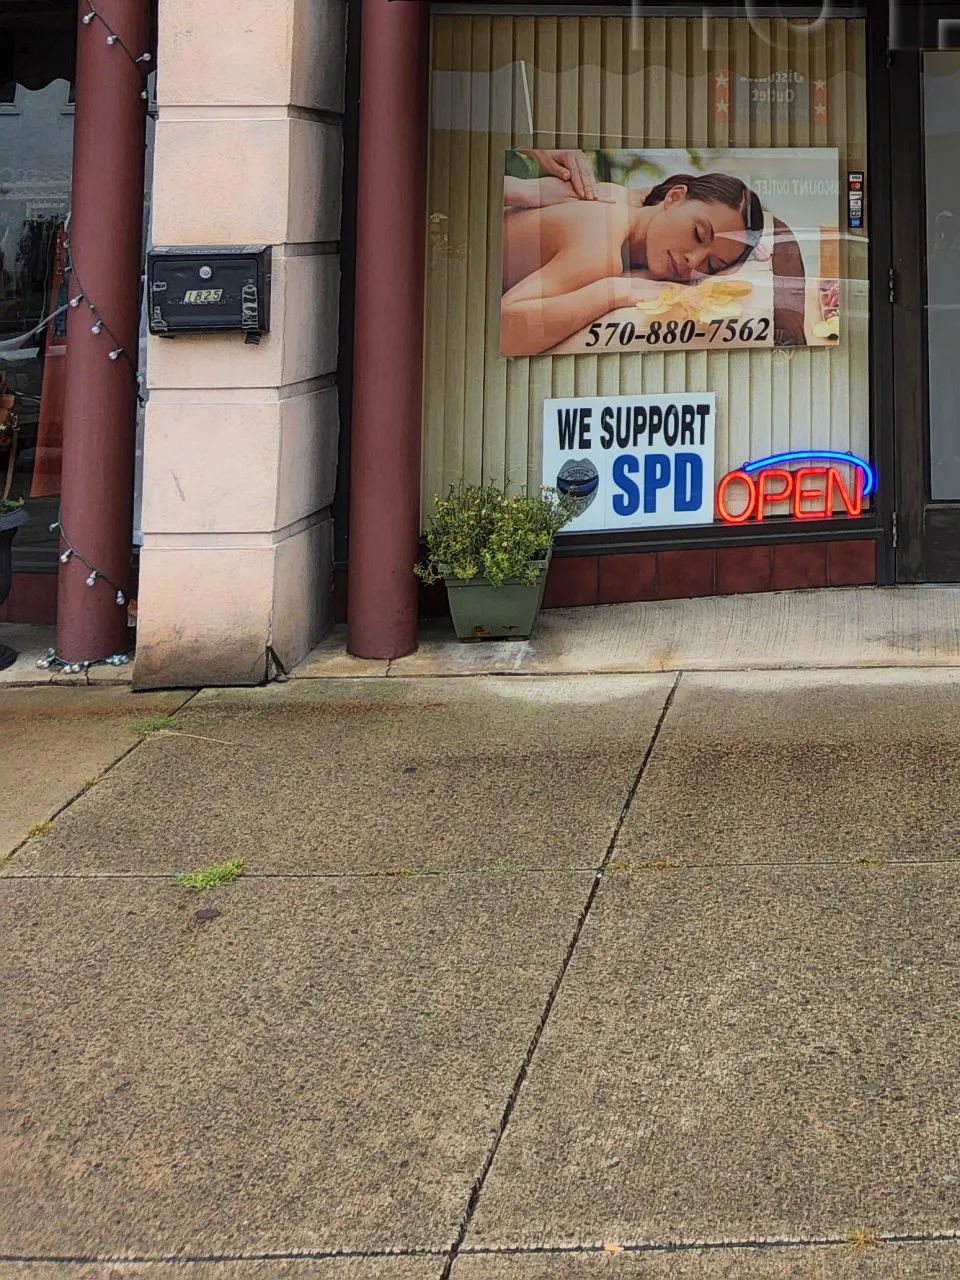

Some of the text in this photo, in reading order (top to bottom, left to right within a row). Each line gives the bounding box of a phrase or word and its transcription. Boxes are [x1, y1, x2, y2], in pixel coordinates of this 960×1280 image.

[186, 290, 221, 301] 1825
[585, 317, 770, 347] 570-880-7562
[557, 404, 710, 450] WE SUPPORT
[612, 452, 704, 516] SPD
[716, 466, 863, 523] OPEN
